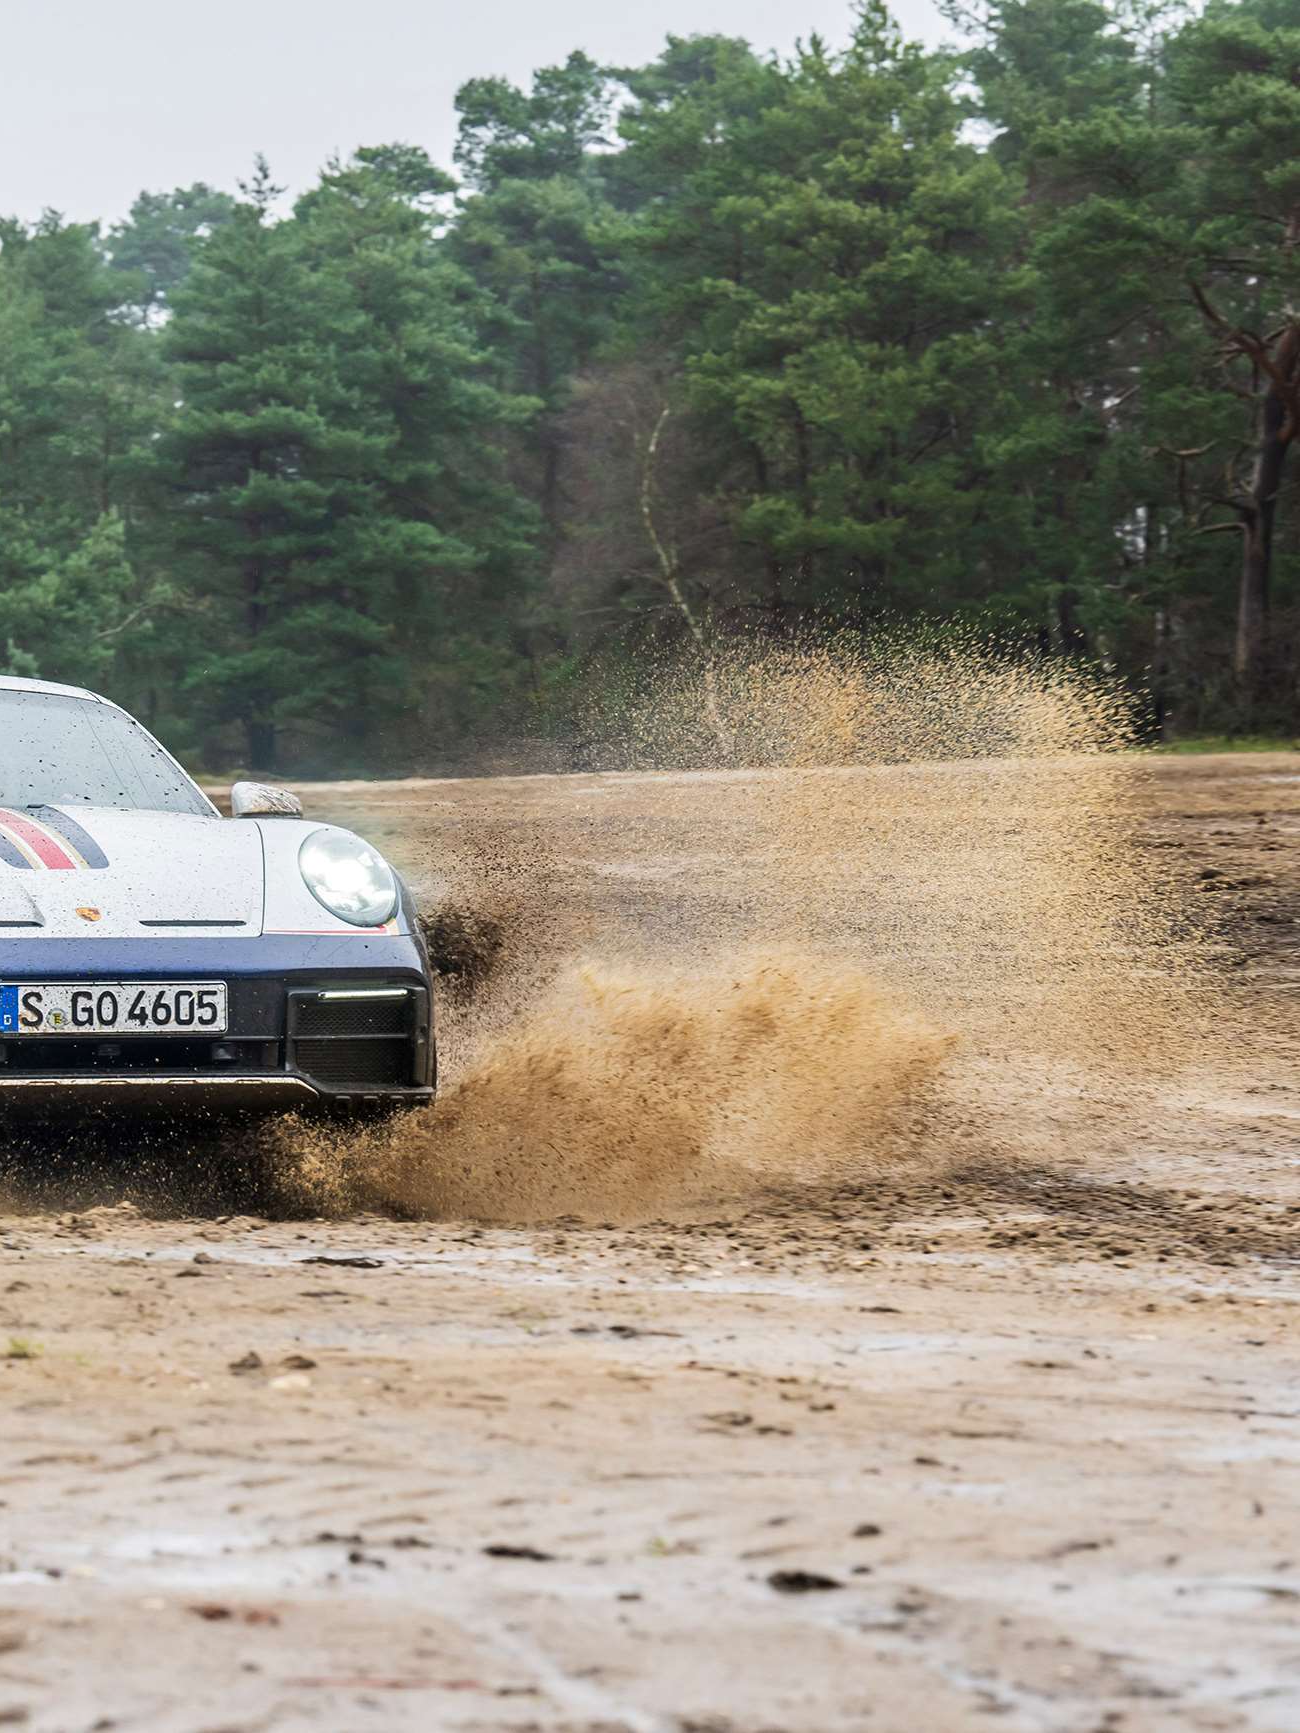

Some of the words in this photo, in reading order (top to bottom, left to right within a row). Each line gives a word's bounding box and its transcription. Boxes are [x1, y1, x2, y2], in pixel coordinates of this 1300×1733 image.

[3, 1014, 12, 1026] D
[21, 991, 44, 1027] S
[70, 990, 119, 1027] GO
[127, 990, 218, 1026] 4605
